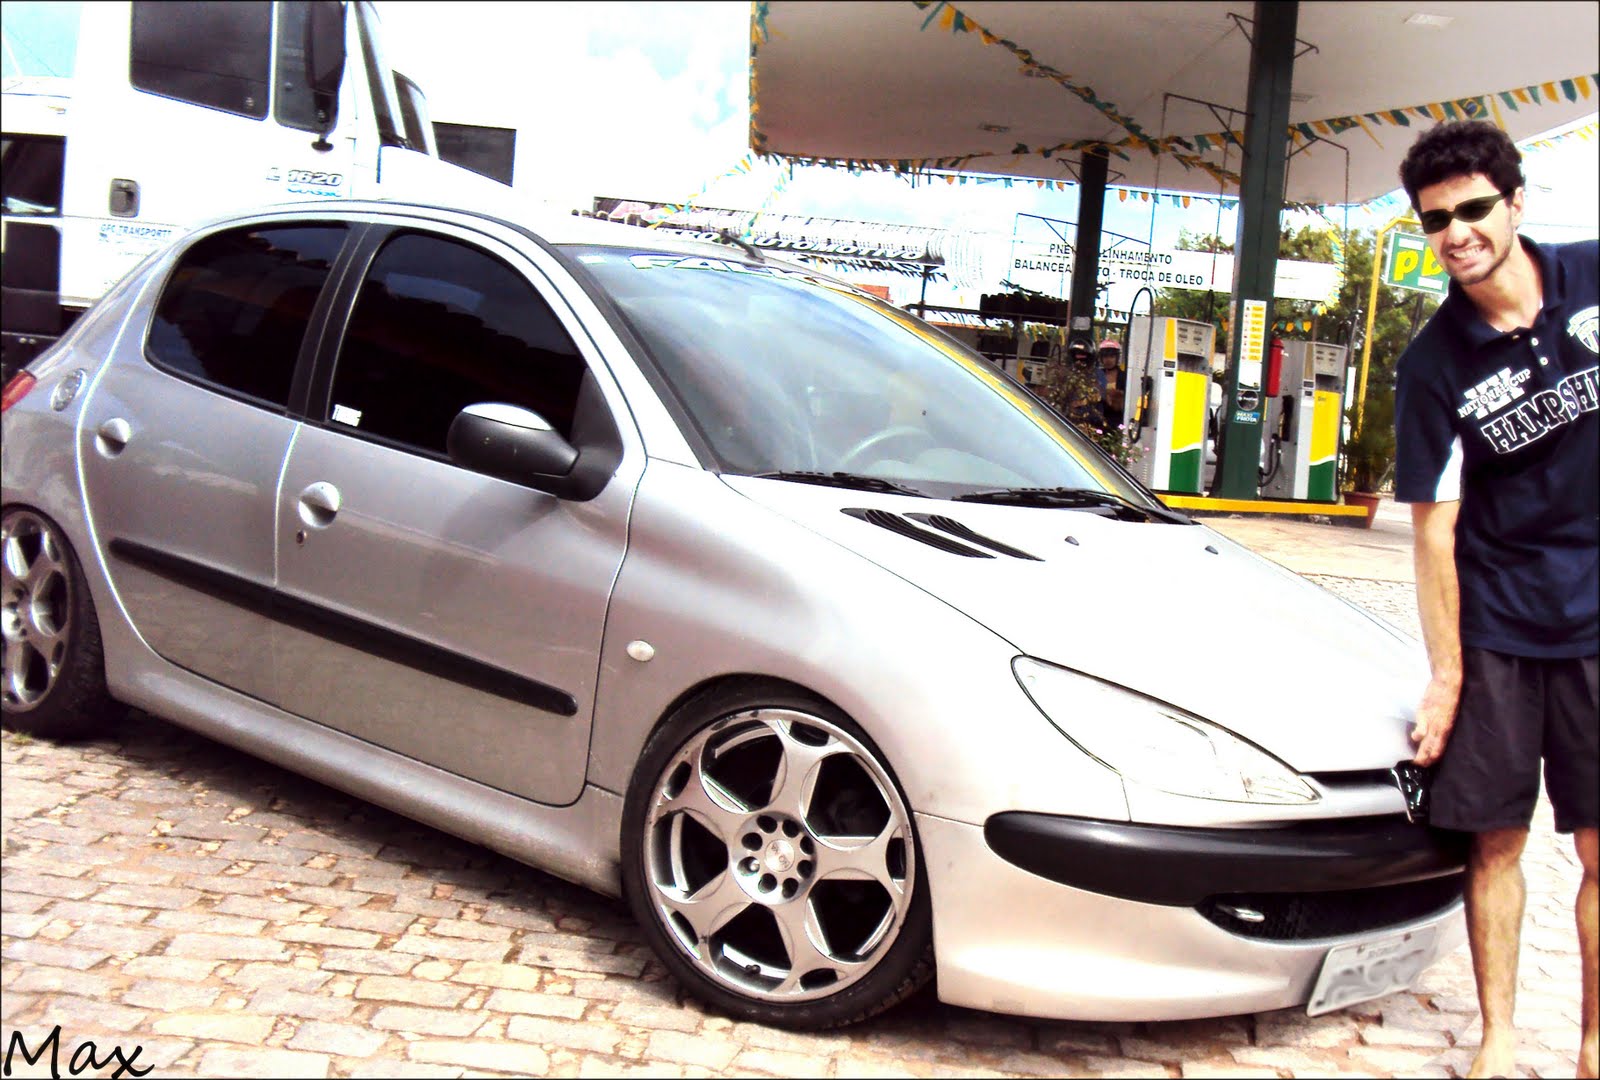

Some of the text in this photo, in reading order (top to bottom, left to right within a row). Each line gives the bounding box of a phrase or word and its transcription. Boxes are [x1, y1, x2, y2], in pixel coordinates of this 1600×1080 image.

[287, 169, 343, 187] 1620
[1099, 248, 1173, 265] LINHAMENTO
[1158, 271, 1173, 283] DE
[1175, 273, 1204, 286] OLEO
[1457, 368, 1532, 418] NATIONAL CUP
